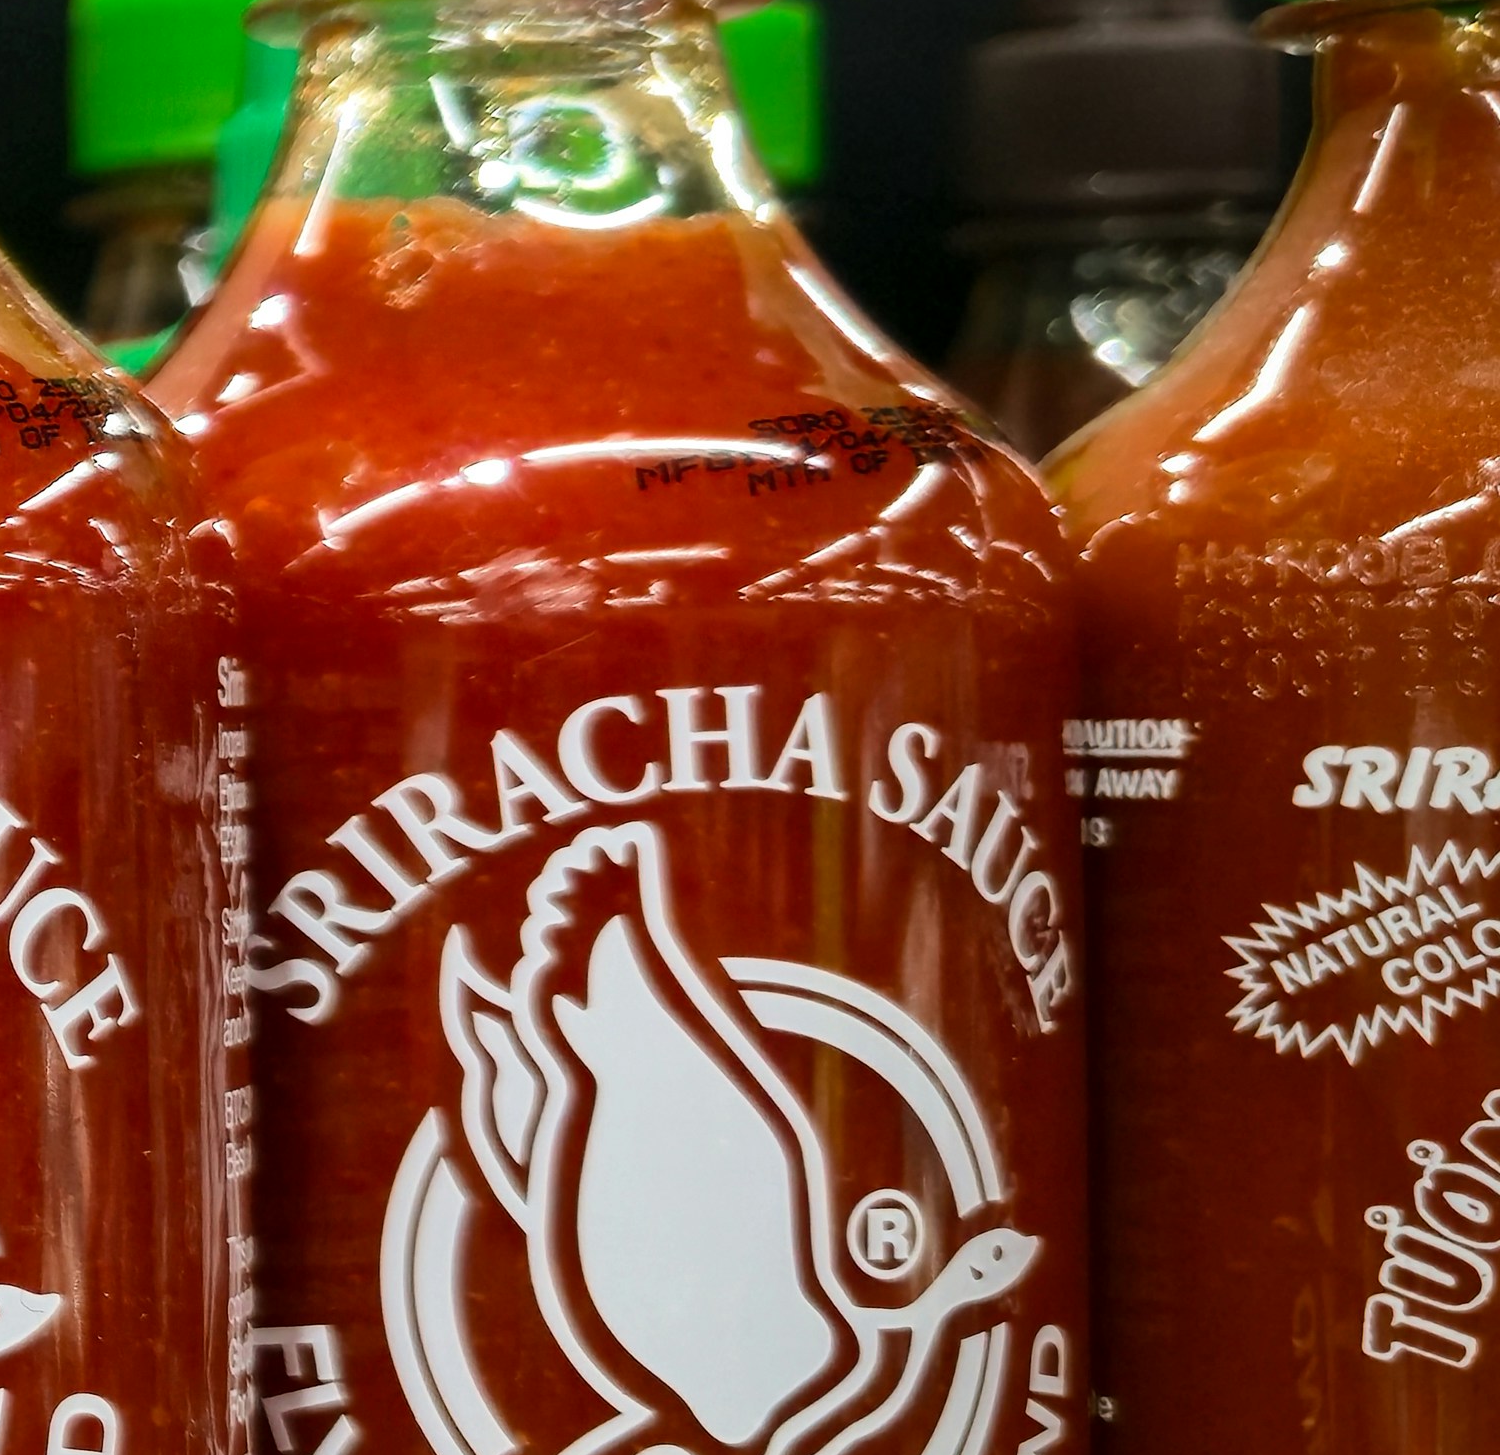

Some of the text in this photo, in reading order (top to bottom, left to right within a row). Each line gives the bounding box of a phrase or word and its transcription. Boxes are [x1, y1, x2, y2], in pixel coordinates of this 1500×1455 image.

[1094, 767, 1180, 800] AWAY
[244, 685, 1075, 1036] SRIRACHA SAUCE
[1269, 885, 1481, 995] NATURAL
[1381, 918, 1500, 995] COLO
